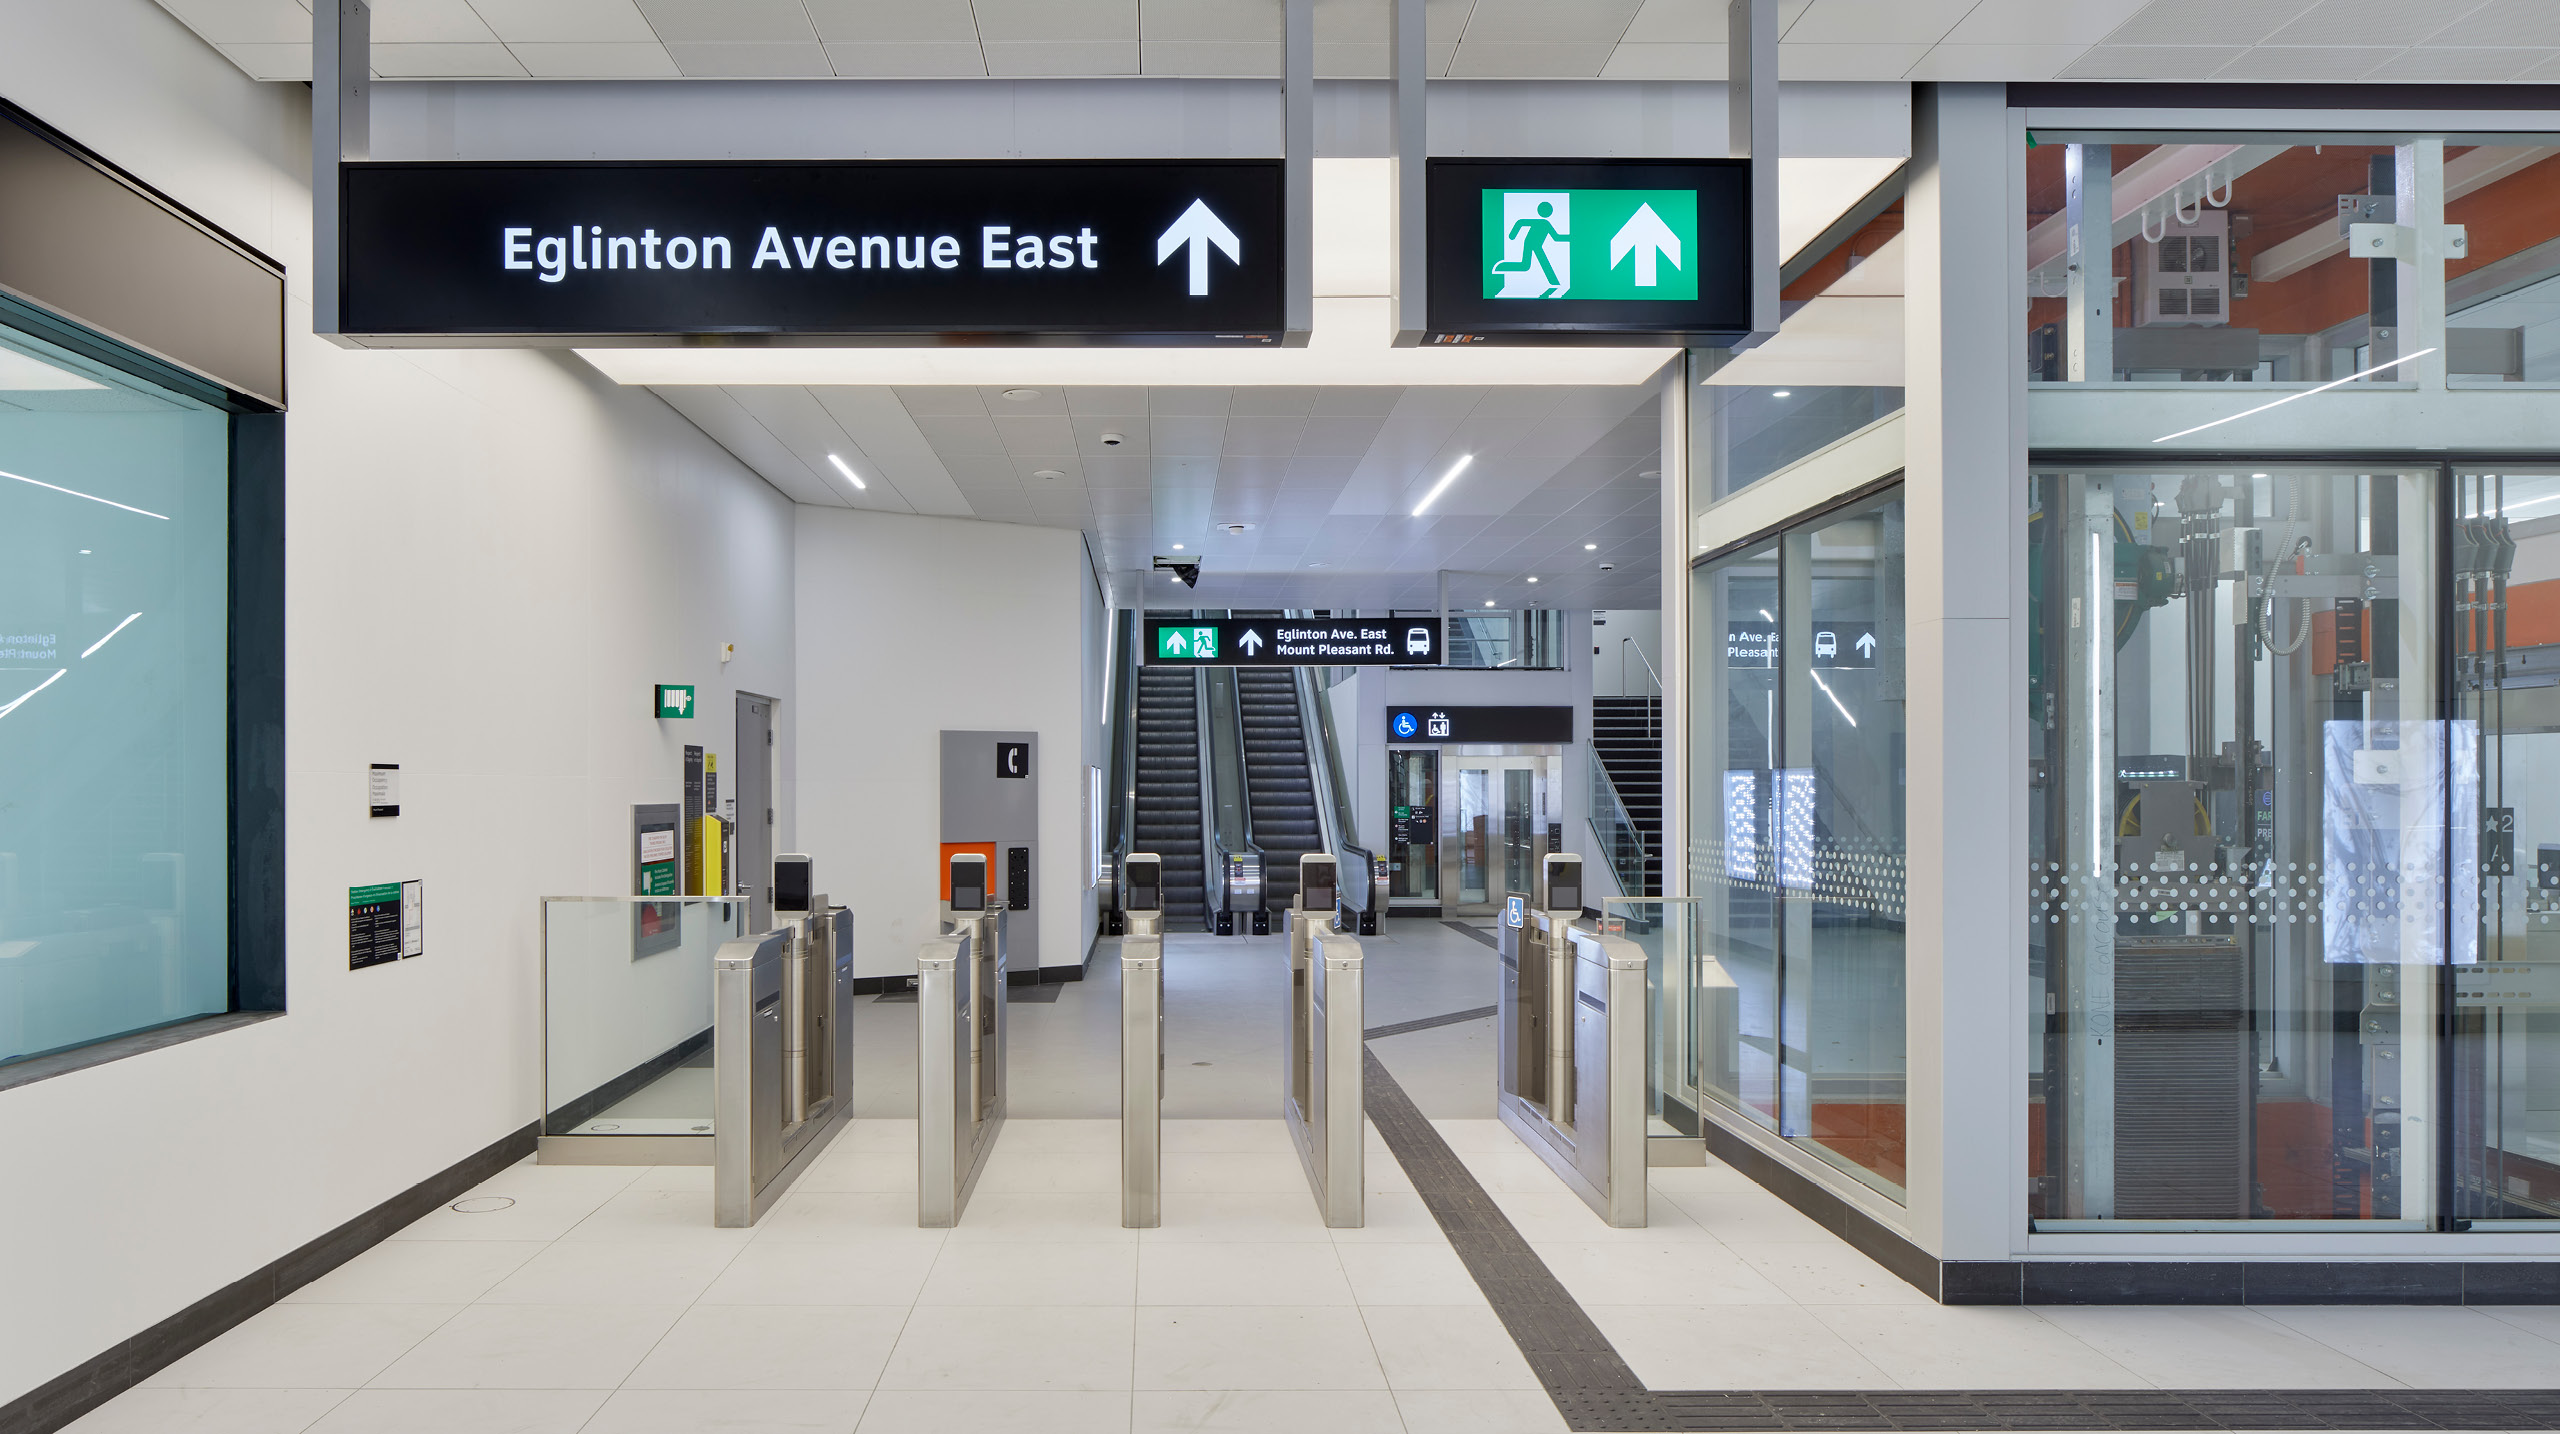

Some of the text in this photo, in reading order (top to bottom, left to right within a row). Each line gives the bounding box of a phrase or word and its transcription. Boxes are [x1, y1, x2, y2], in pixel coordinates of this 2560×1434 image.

[502, 225, 1098, 284] Eglinton Avenue East
[1277, 628, 1387, 642] Eglinton Ave. East
[1739, 631, 1767, 642] Ave.
[1277, 644, 1395, 655] Mount Pleasant Rd.
[2501, 814, 2514, 833] 2
